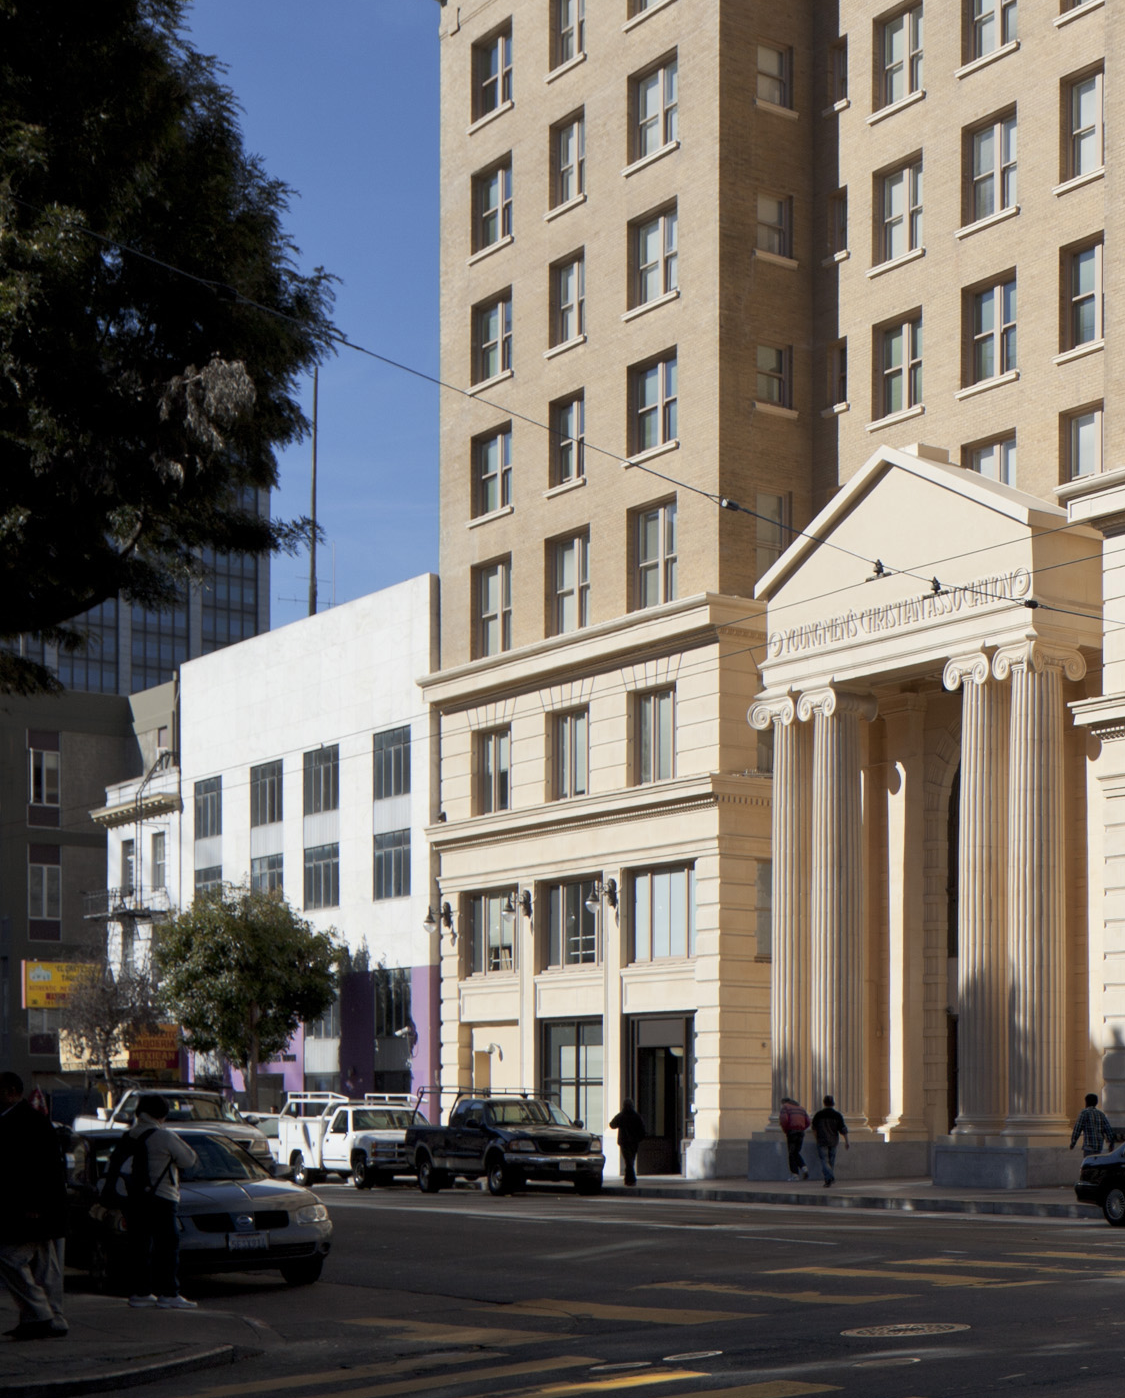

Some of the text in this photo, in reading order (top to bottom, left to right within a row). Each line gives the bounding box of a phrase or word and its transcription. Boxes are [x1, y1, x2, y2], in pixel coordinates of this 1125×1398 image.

[784, 571, 1013, 653] YOUNG MEN'S CHRISTIAN ASSOCIATION
[131, 1051, 175, 1061] MEXICAN
[139, 1060, 167, 1069] FOOD
